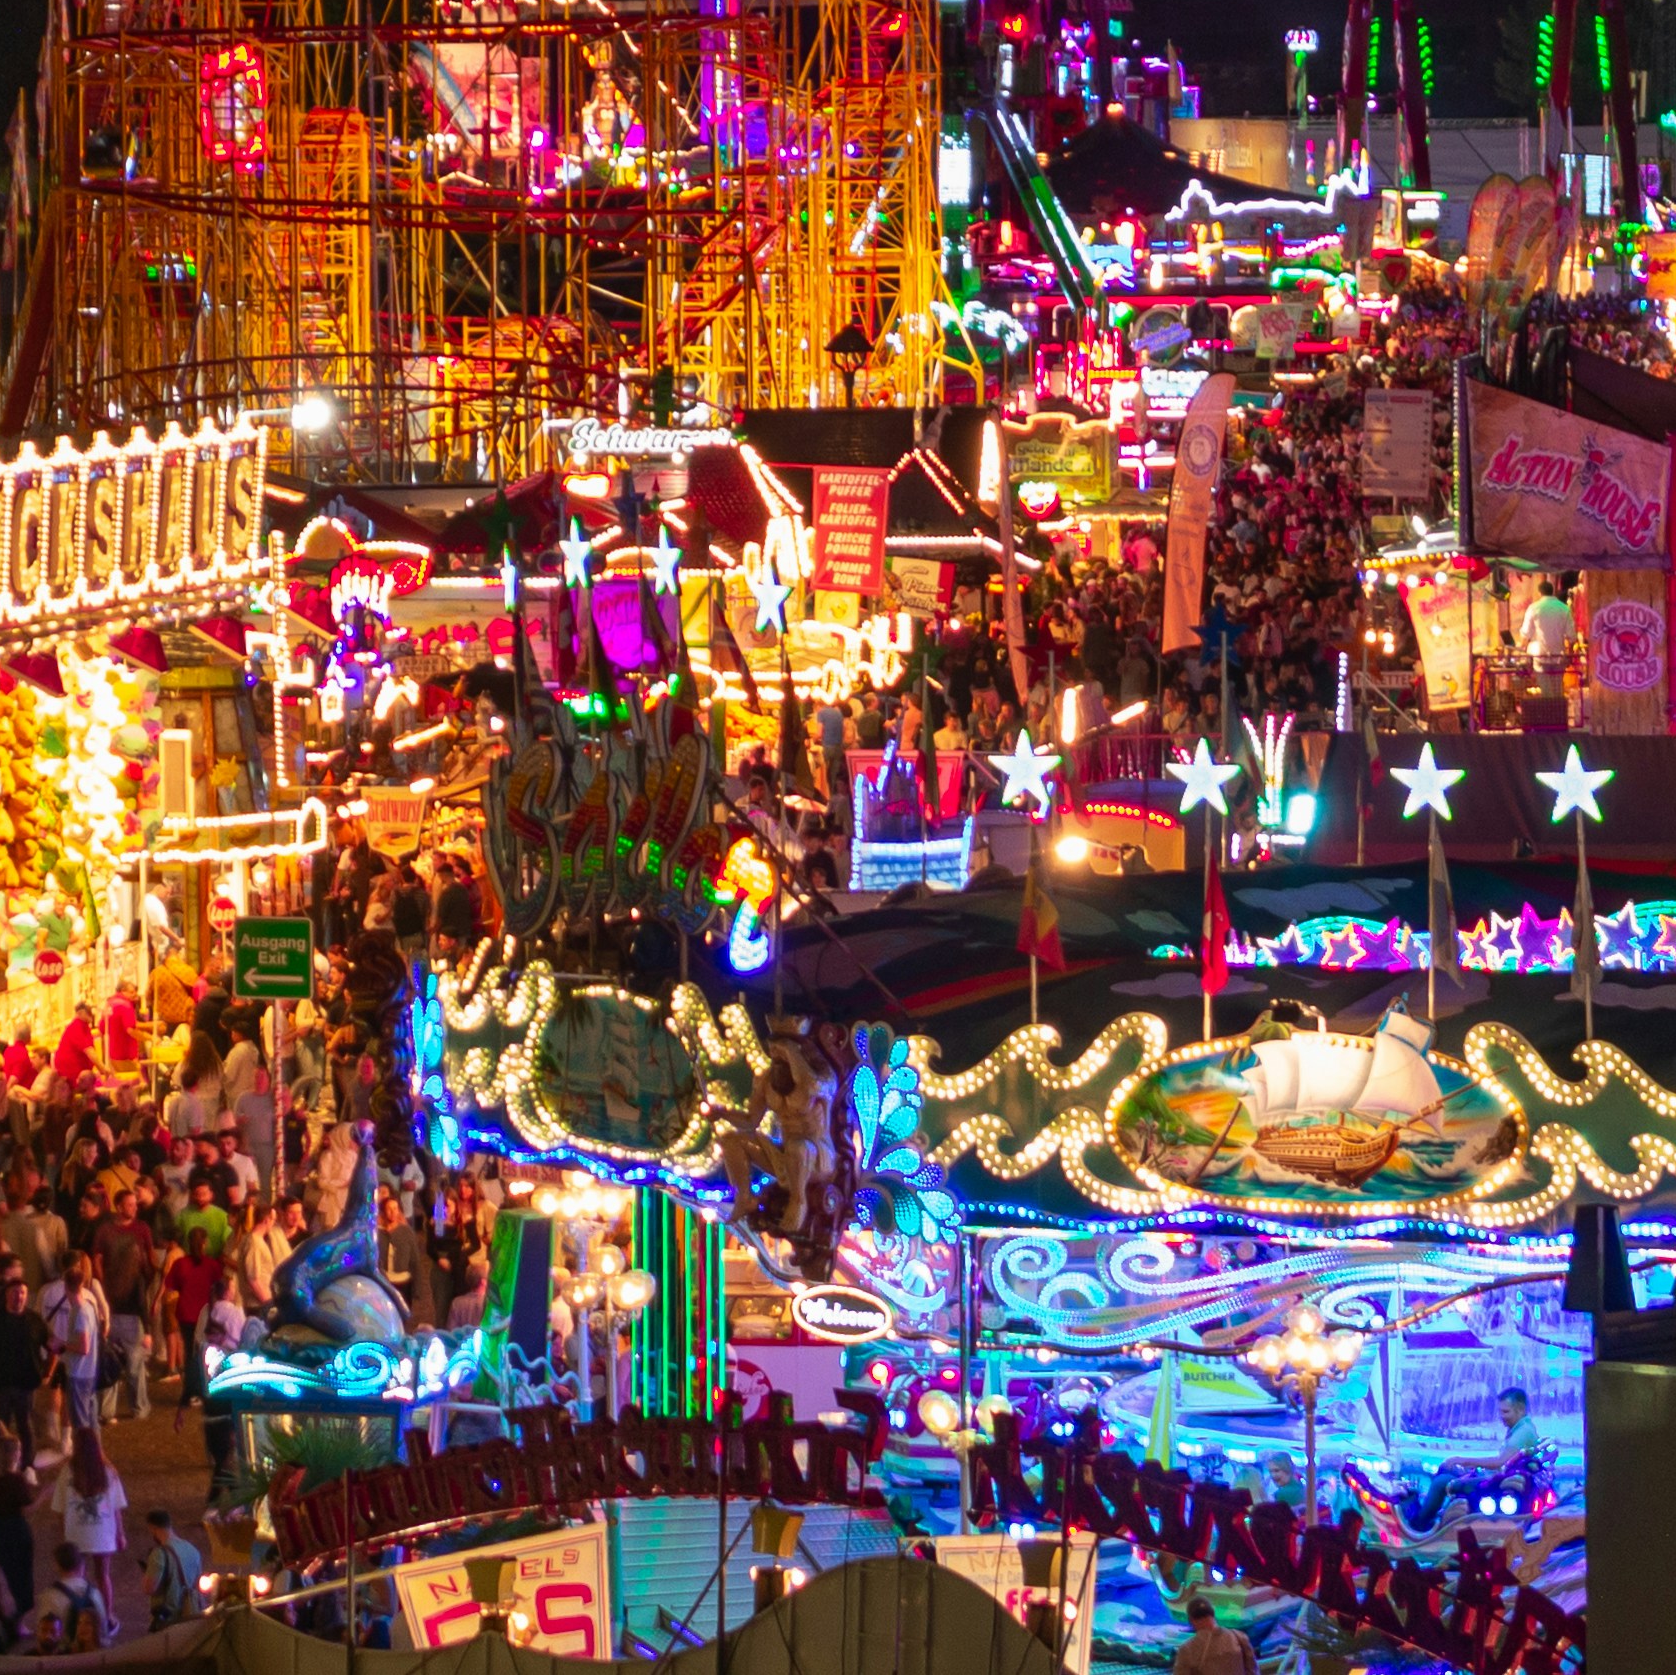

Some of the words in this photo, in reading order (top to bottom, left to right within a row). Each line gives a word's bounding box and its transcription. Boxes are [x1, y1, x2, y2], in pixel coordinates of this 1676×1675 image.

[1485, 437, 1577, 496] ACTION
[819, 473, 884, 485] KARTOFFEL-
[829, 485, 872, 497] PUFFER
[829, 502, 873, 514] FOLIEN-
[1581, 470, 1663, 550] HOUSE
[819, 514, 877, 528] KARTOFFEL
[828, 532, 872, 545] FRISCHE
[825, 544, 871, 557] POMMES
[826, 560, 871, 575] POMMES
[833, 573, 862, 585] BOWL
[1592, 600, 1664, 640] ACTION
[1595, 656, 1663, 692] HOUSE
[366, 795, 423, 824] Bratwurst
[211, 905, 236, 922] Lose
[240, 933, 306, 954] Ausgang
[35, 958, 63, 976] Lose
[257, 951, 287, 966] Exit
[801, 1297, 886, 1328] Welcome
[1182, 1368, 1237, 1386] BUTCHER
